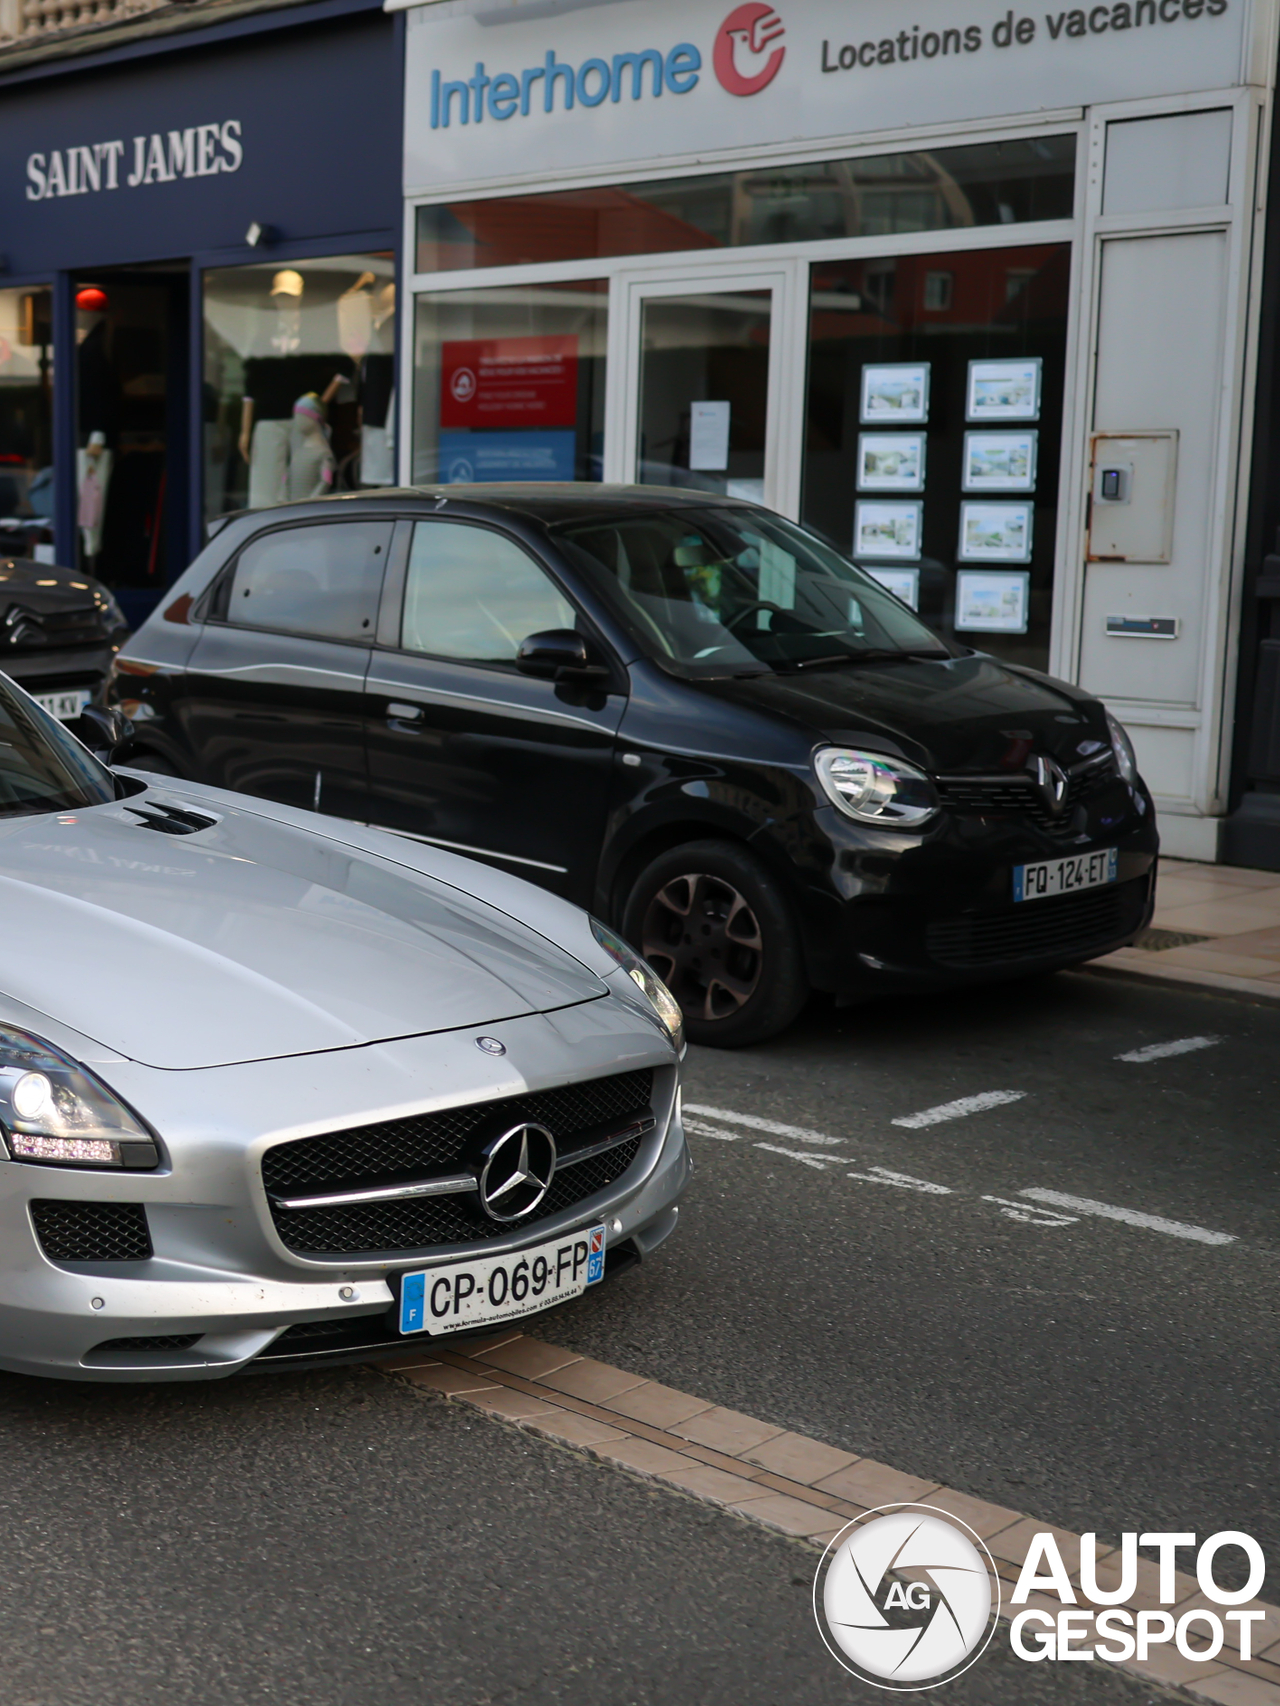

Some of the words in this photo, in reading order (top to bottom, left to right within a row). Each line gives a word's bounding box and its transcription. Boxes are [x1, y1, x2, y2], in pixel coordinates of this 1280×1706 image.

[821, 24, 982, 73] Locations
[991, 10, 1036, 48] de
[1045, 0, 1228, 40] vacances
[430, 43, 702, 129] Interhome
[26, 140, 124, 200] SAINT
[127, 120, 243, 187] JAMES
[430, 1240, 588, 1318] CP-069-FP
[589, 1256, 602, 1278] 67
[409, 1308, 416, 1322] F
